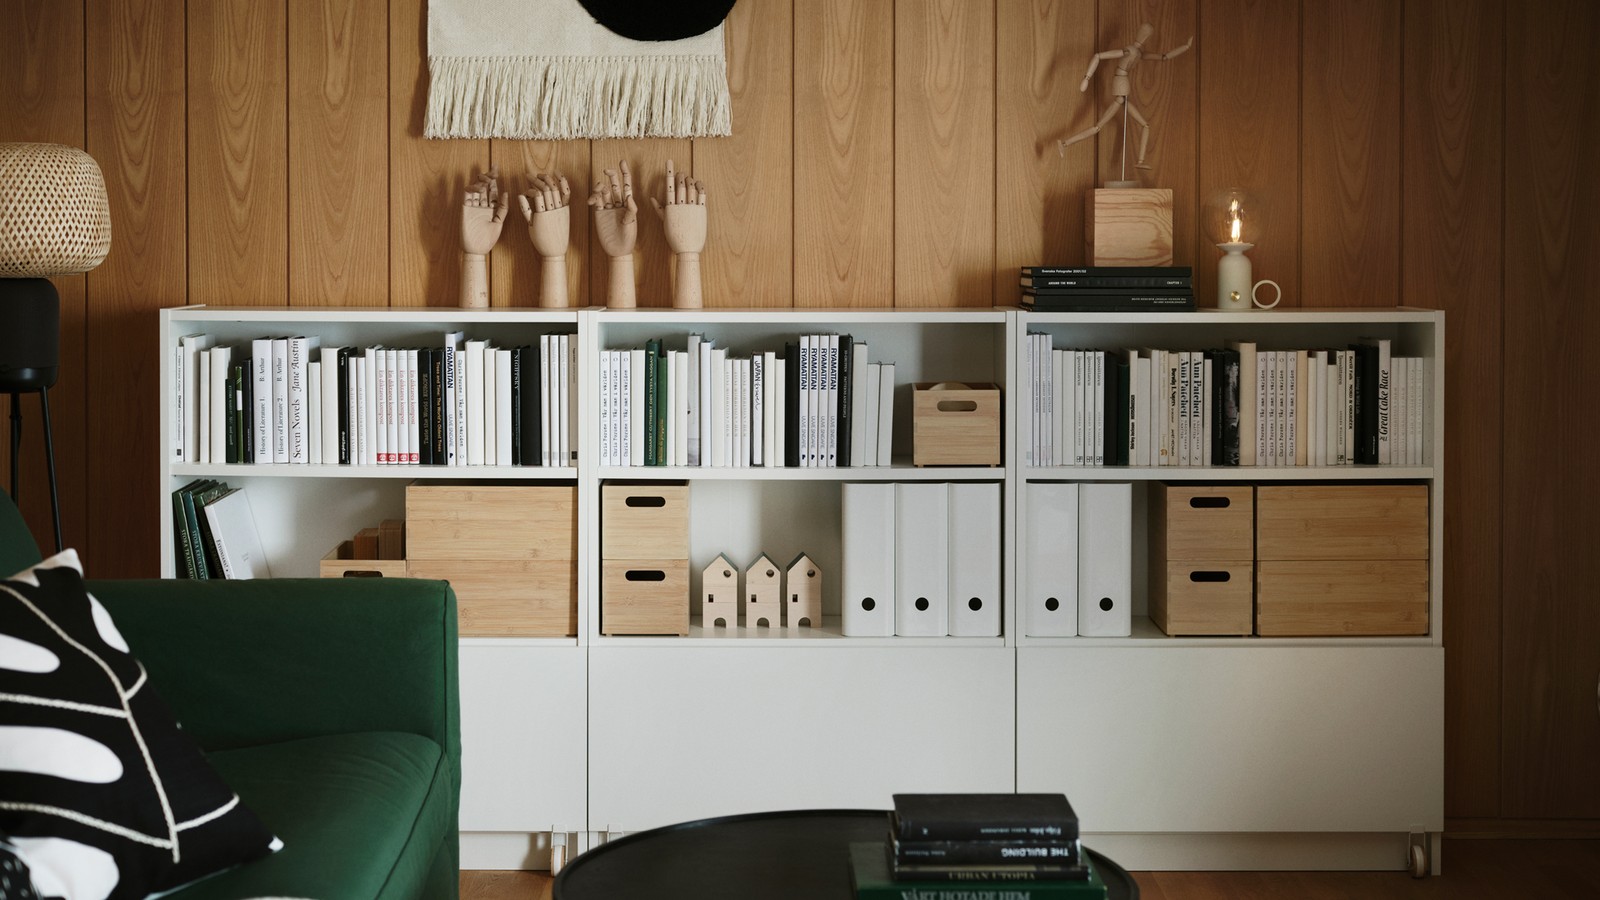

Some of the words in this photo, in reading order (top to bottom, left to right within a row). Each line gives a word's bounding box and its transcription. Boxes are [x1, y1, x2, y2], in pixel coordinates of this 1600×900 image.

[291, 340, 300, 370] Austin
[379, 370, 385, 378] En
[388, 370, 395, 378] En
[399, 370, 406, 378] En
[410, 370, 417, 378] En
[1180, 359, 1188, 378] Ann
[1193, 359, 1201, 378] Ann
[291, 371, 302, 392] Jane
[1379, 370, 1388, 390] Race
[1180, 380, 1188, 418] Patchett
[1193, 380, 1201, 418] Patchett
[1379, 391, 1388, 411] Cake
[292, 399, 301, 429] Novels
[1379, 413, 1388, 435] Great
[293, 432, 301, 459] Seven
[1001, 848, 1048, 856] BUILDING
[1050, 848, 1069, 856] THE
[949, 872, 989, 880] URBAN
[992, 872, 1035, 880] UTOPIA
[901, 888, 937, 900] VÅRT
[940, 892, 995, 900] HOTADE
[996, 892, 1030, 900] HEM
